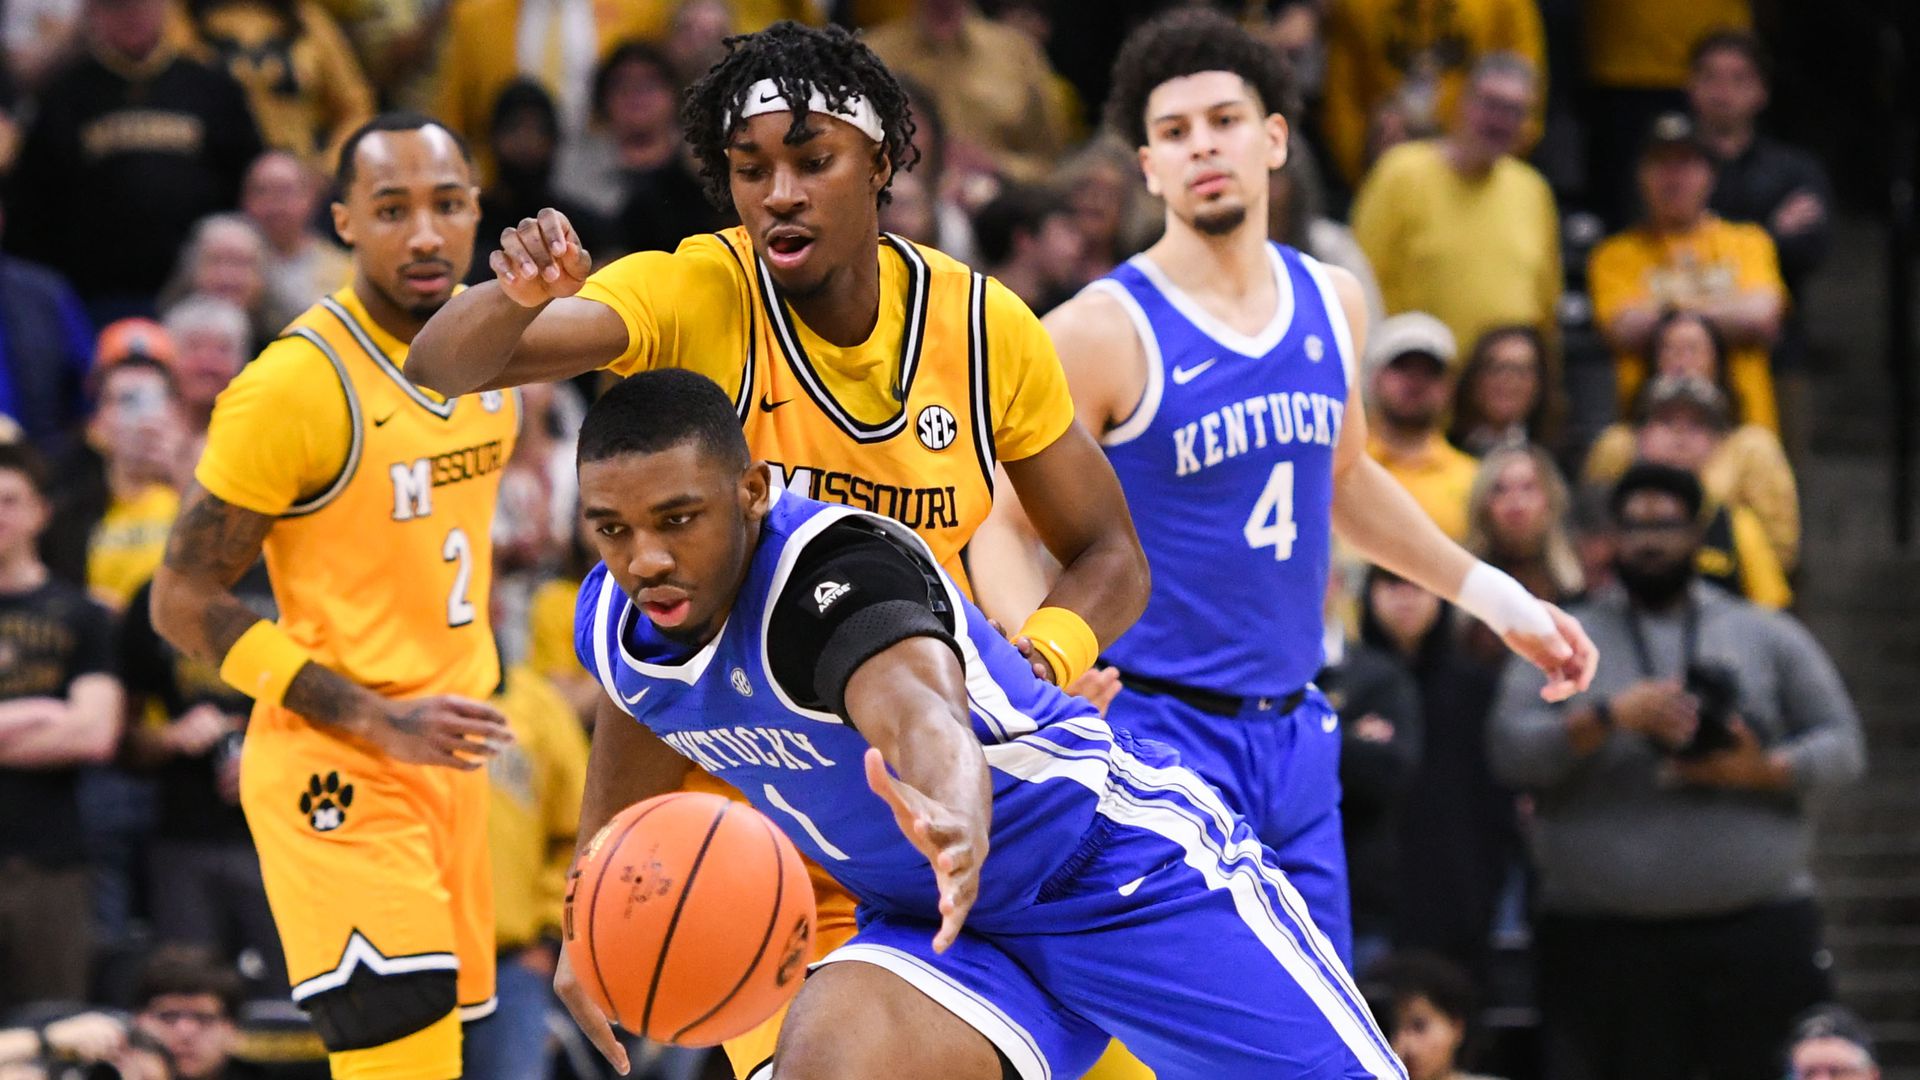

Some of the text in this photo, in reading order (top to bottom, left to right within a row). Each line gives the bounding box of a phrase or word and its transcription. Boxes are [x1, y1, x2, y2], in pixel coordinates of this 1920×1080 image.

[917, 405, 956, 450] SEC
[1243, 460, 1297, 561] 4
[443, 527, 475, 628] 2
[660, 726, 837, 772] ENTUCKY
[763, 783, 850, 861] 1
